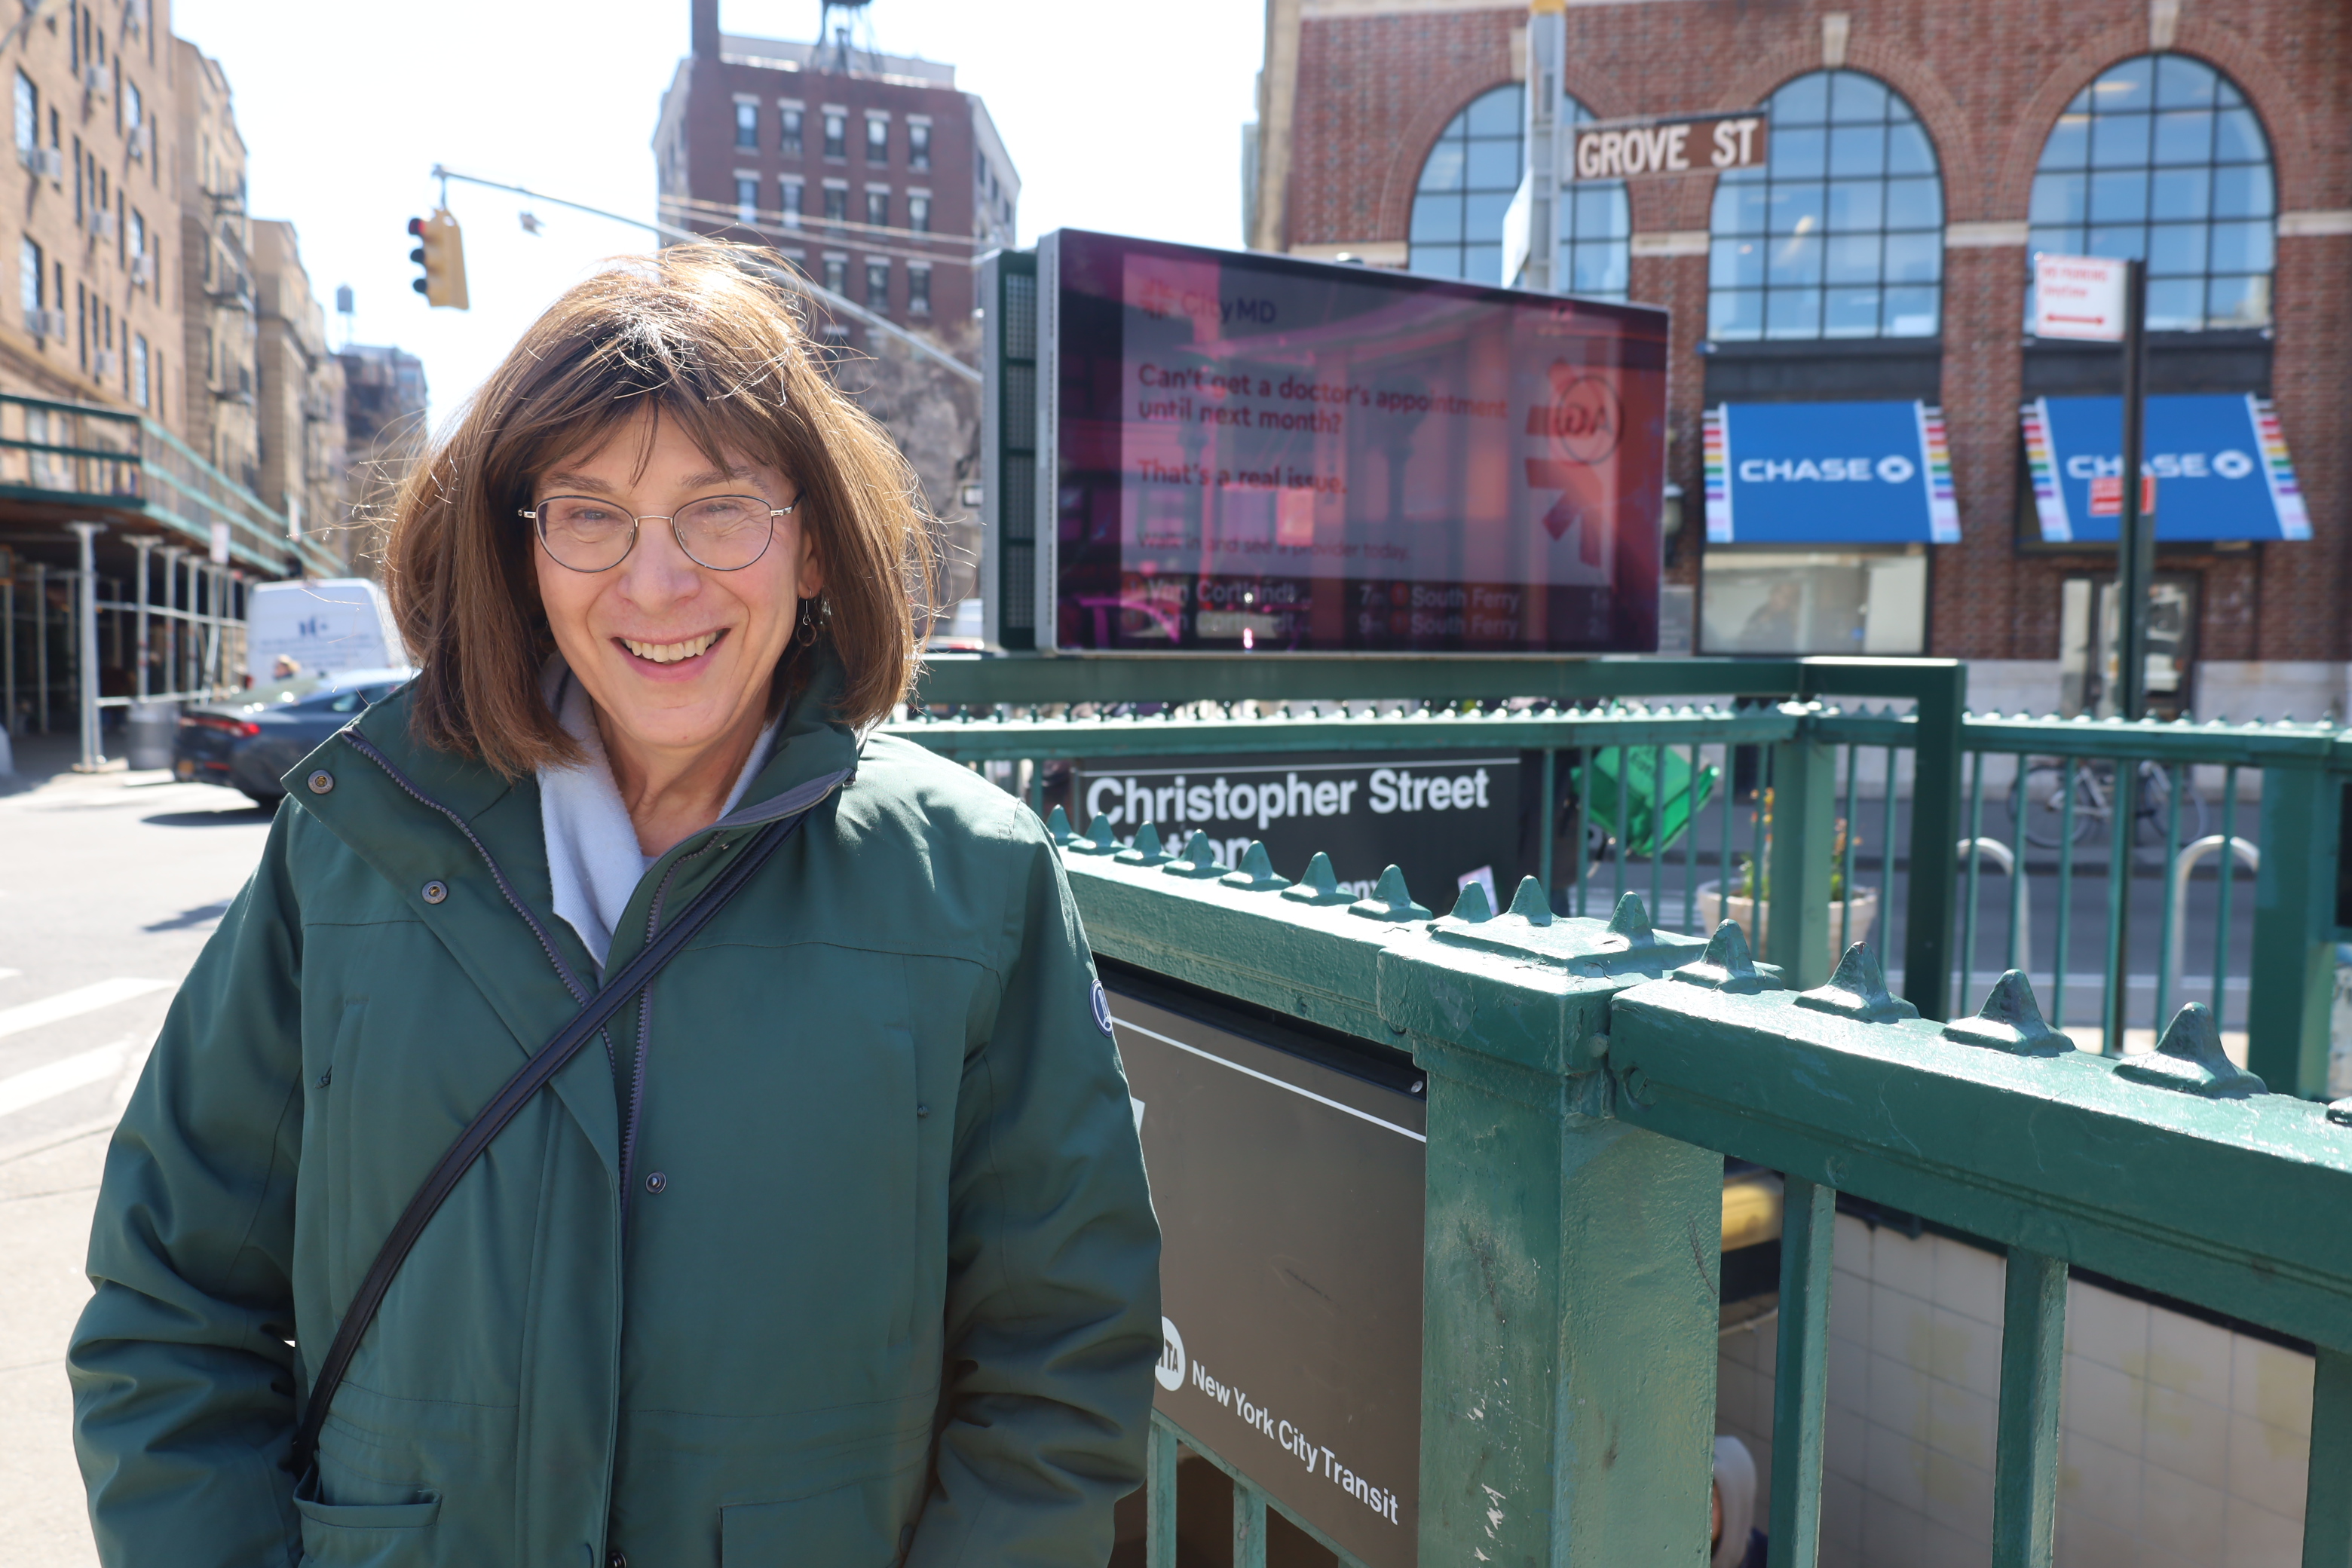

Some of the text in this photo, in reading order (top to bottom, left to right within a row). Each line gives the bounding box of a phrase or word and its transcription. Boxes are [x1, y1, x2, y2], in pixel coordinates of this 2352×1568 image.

[1578, 118, 1759, 178] GROVE ST
[1138, 363, 1508, 419] Can't get a doctor's appointment
[1138, 397, 1345, 436] until next month?
[1137, 458, 1348, 494] That's a real issue.
[1738, 458, 1874, 483] CHASE
[1411, 585, 1467, 608] South
[1472, 587, 1521, 614] Ferry
[1086, 767, 1490, 829] Christopher Street
[1192, 1359, 1398, 1526] New York City Transit
